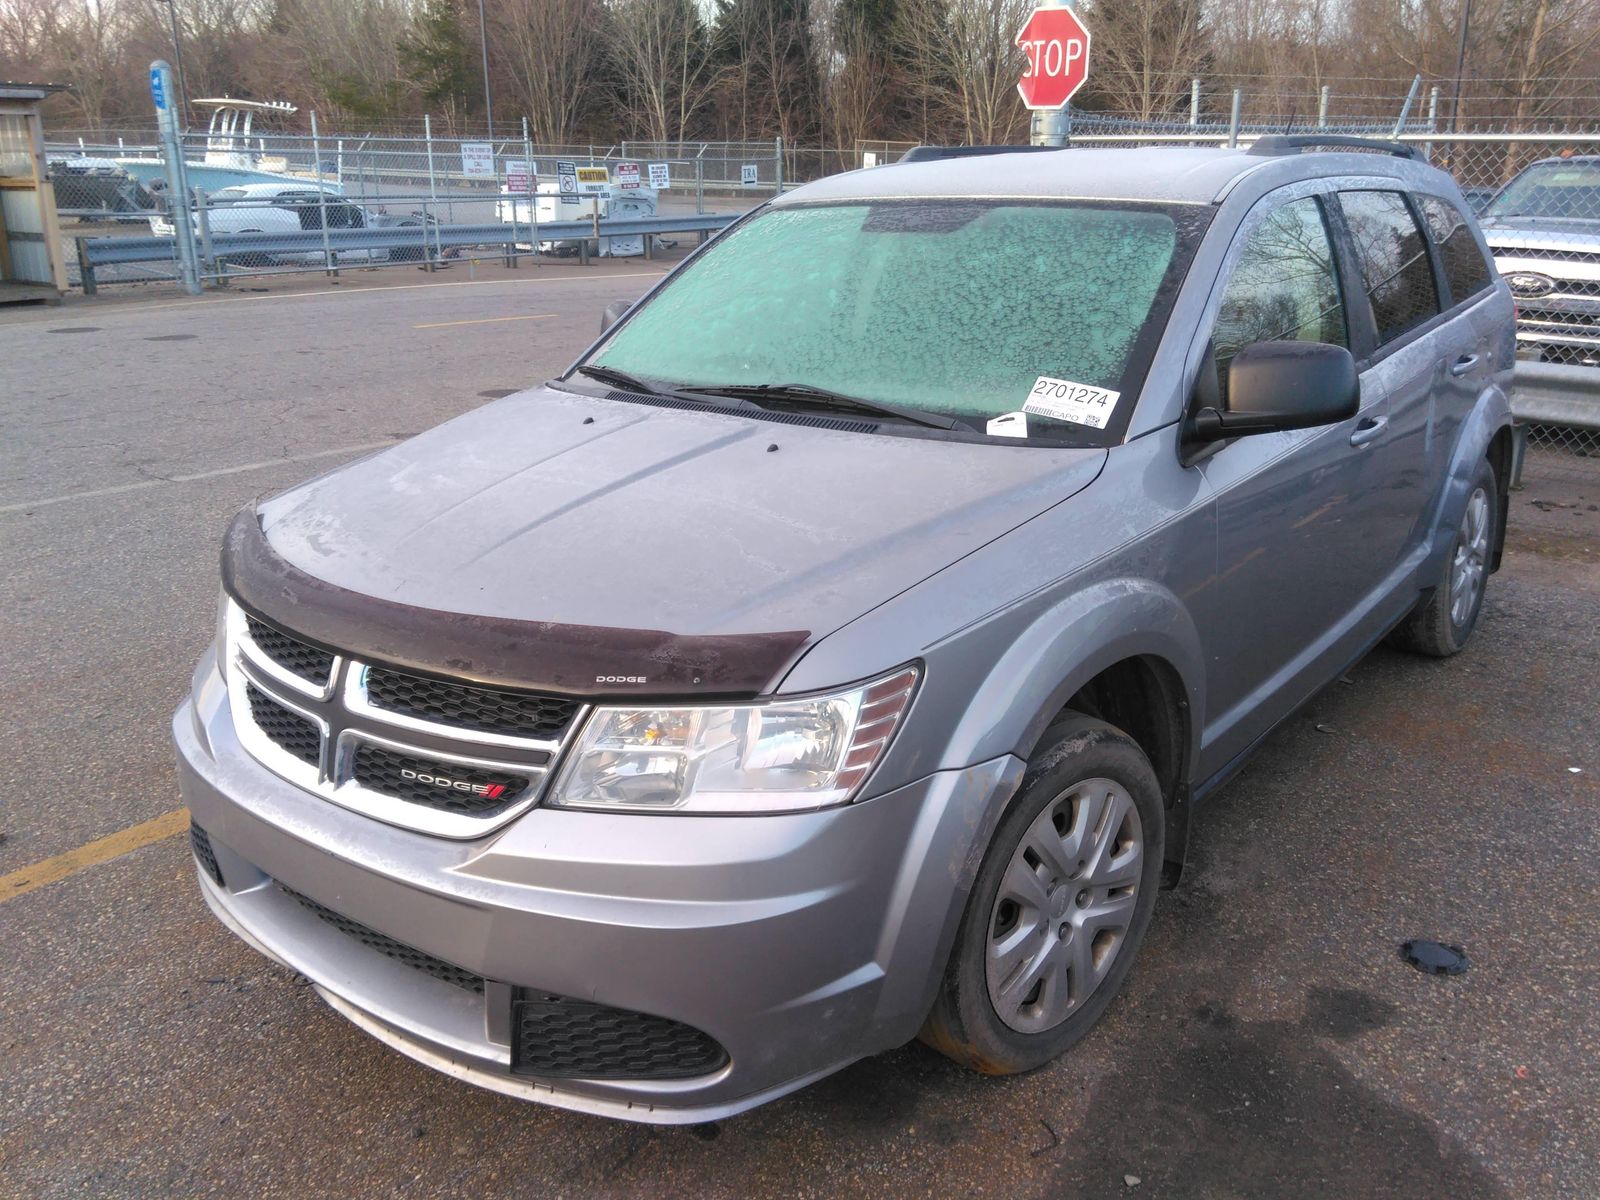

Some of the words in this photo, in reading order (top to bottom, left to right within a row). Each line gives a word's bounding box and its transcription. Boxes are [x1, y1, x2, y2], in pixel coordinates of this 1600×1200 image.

[1021, 38, 1082, 78] STOP
[579, 171, 607, 181] CAUTION
[1034, 380, 1108, 407] 2701274
[401, 769, 489, 794] DODGE
